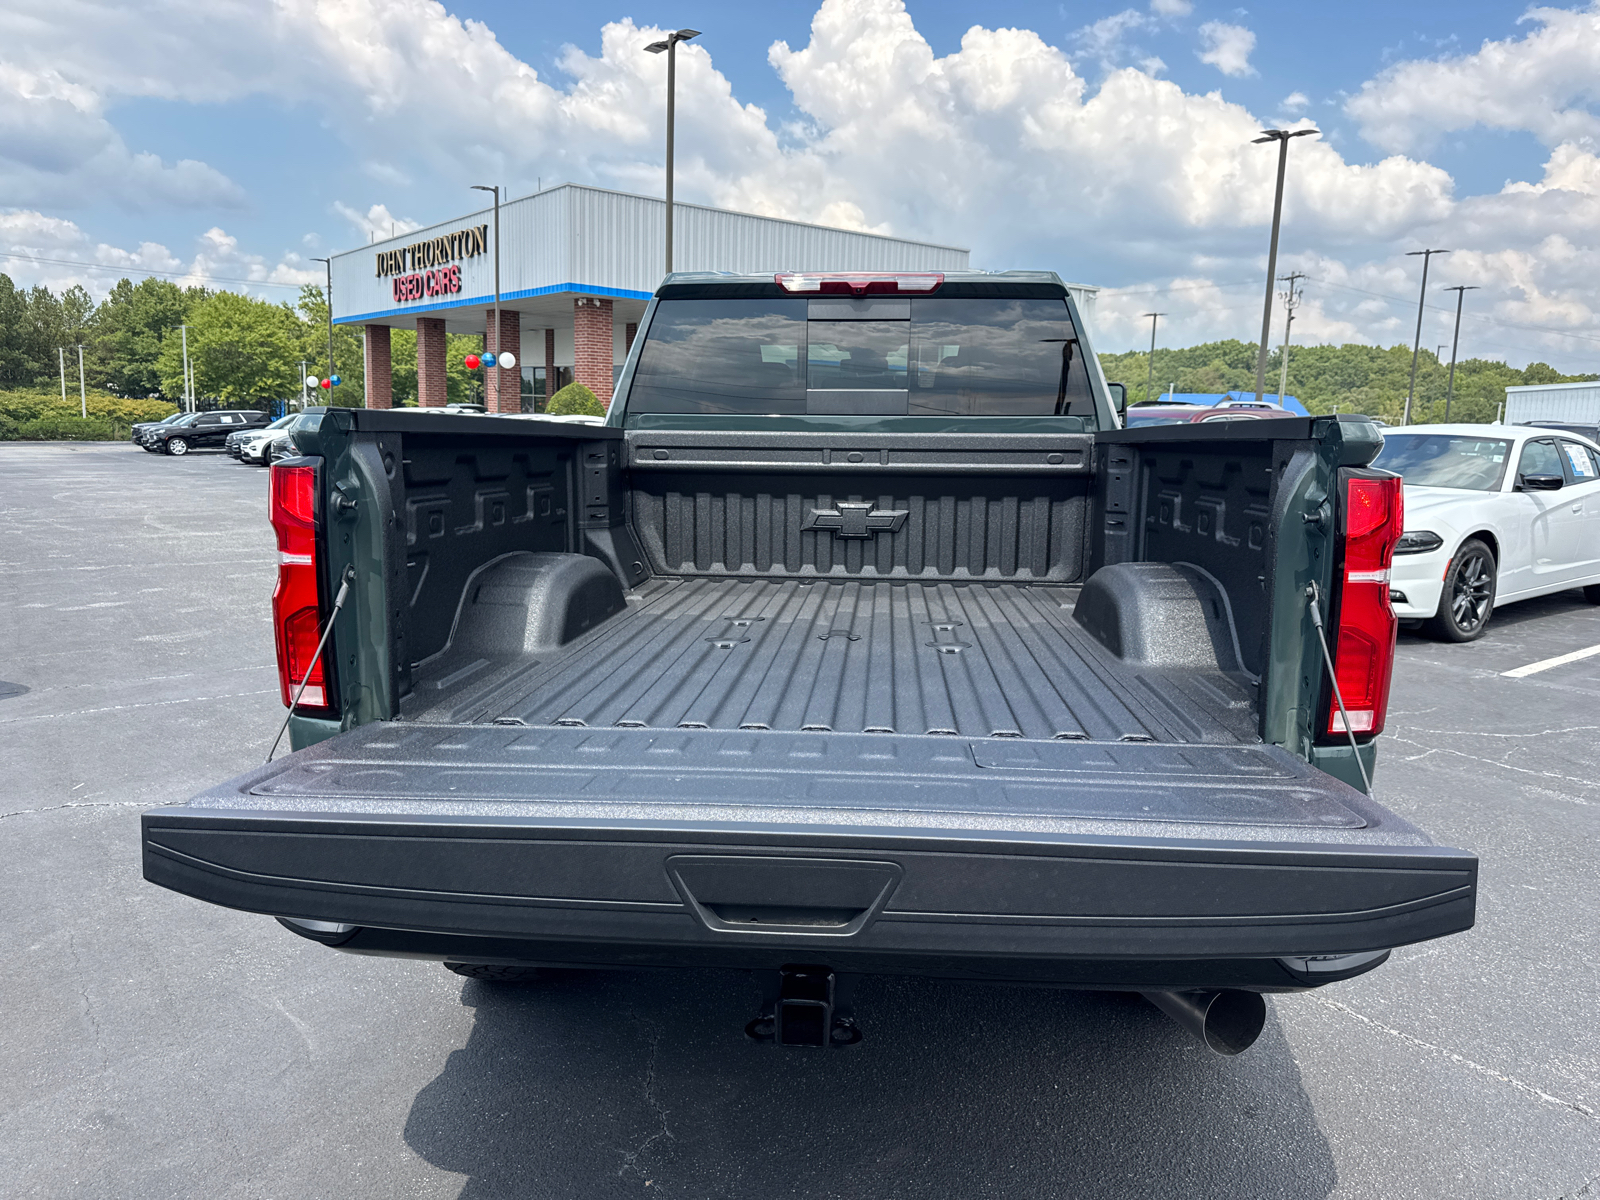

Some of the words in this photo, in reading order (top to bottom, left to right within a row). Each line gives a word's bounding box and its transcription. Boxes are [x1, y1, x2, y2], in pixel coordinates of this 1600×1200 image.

[375, 248, 406, 278] JOHN
[407, 224, 488, 271] THORNTON
[392, 273, 423, 302] USED
[424, 264, 461, 297] CARS
